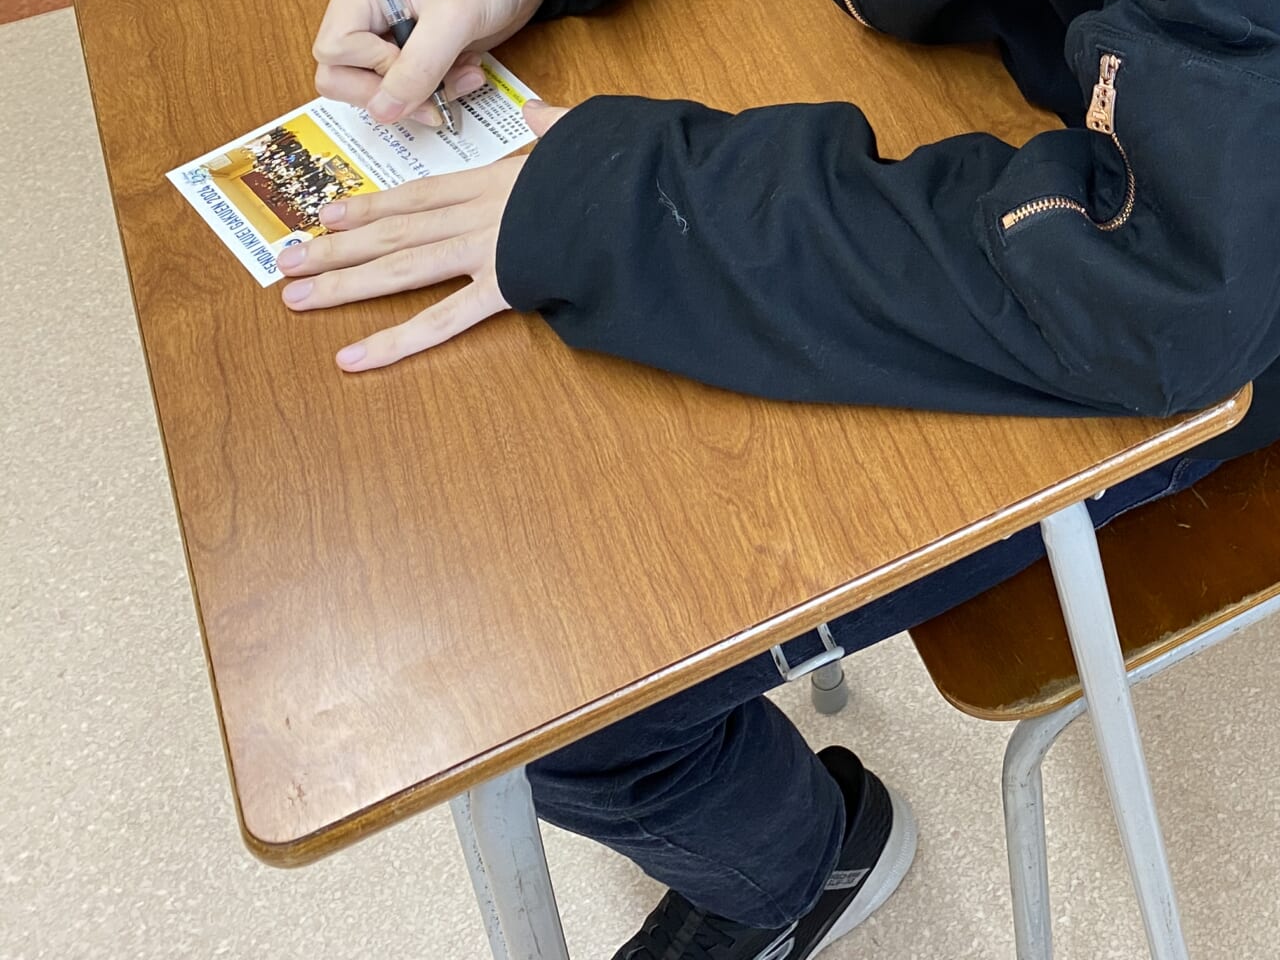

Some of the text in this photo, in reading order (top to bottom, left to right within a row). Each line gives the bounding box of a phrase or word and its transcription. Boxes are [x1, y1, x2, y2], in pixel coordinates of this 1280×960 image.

[196, 183, 281, 275] SENDAI IKUEI GAKUEN 2024
